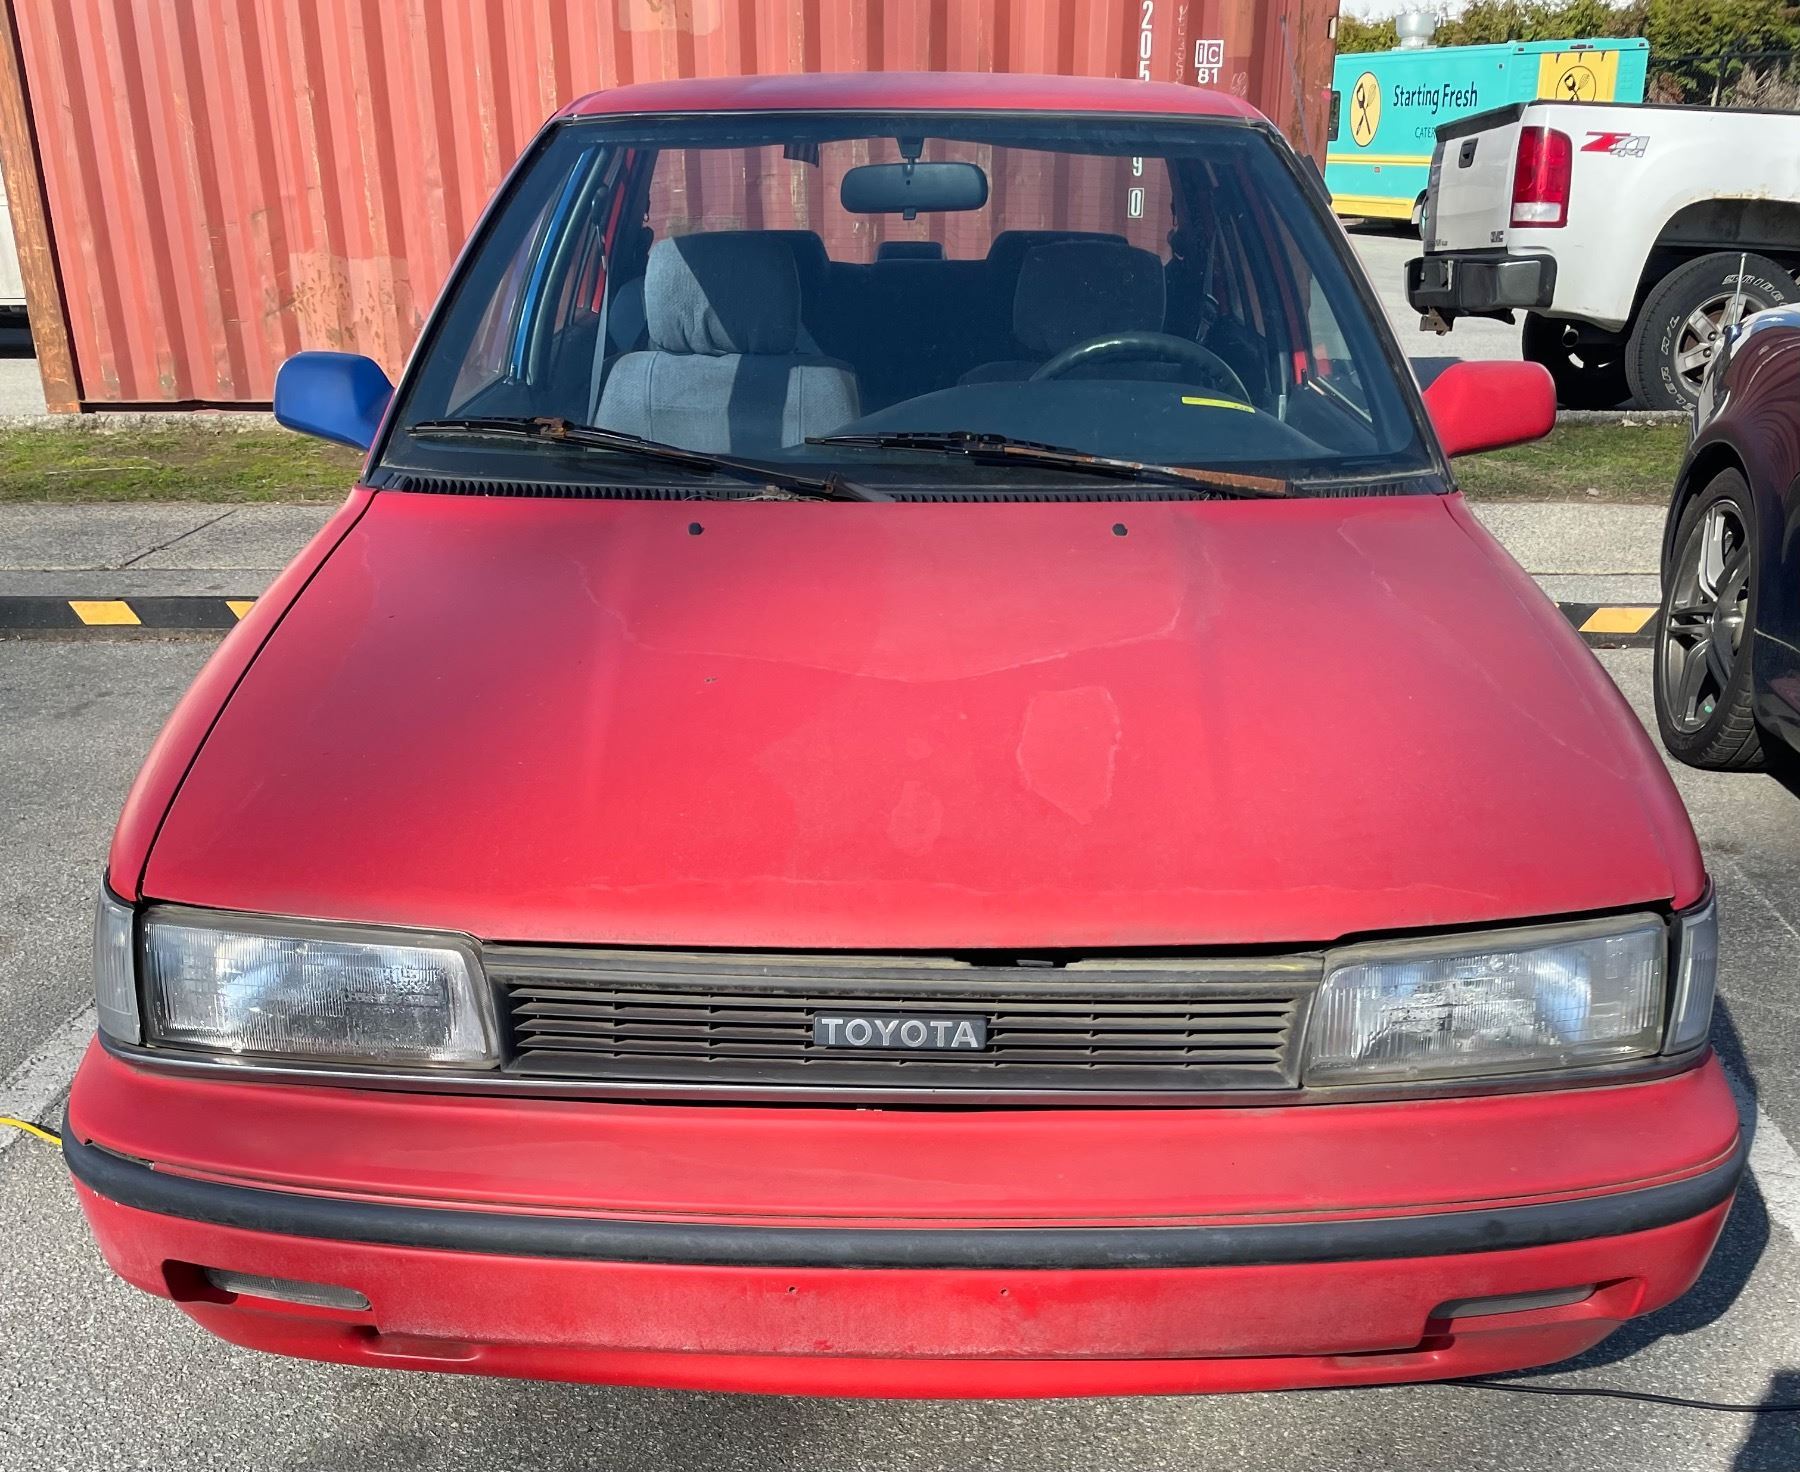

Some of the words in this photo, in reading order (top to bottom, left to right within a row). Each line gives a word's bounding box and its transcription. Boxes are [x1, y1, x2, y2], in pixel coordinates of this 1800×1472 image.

[1198, 68, 1218, 84] 81
[1393, 83, 1440, 115] Starting
[1442, 81, 1478, 107] Fresh
[1722, 274, 1788, 306] BRIDG
[821, 1018, 979, 1048] TOYOTA
